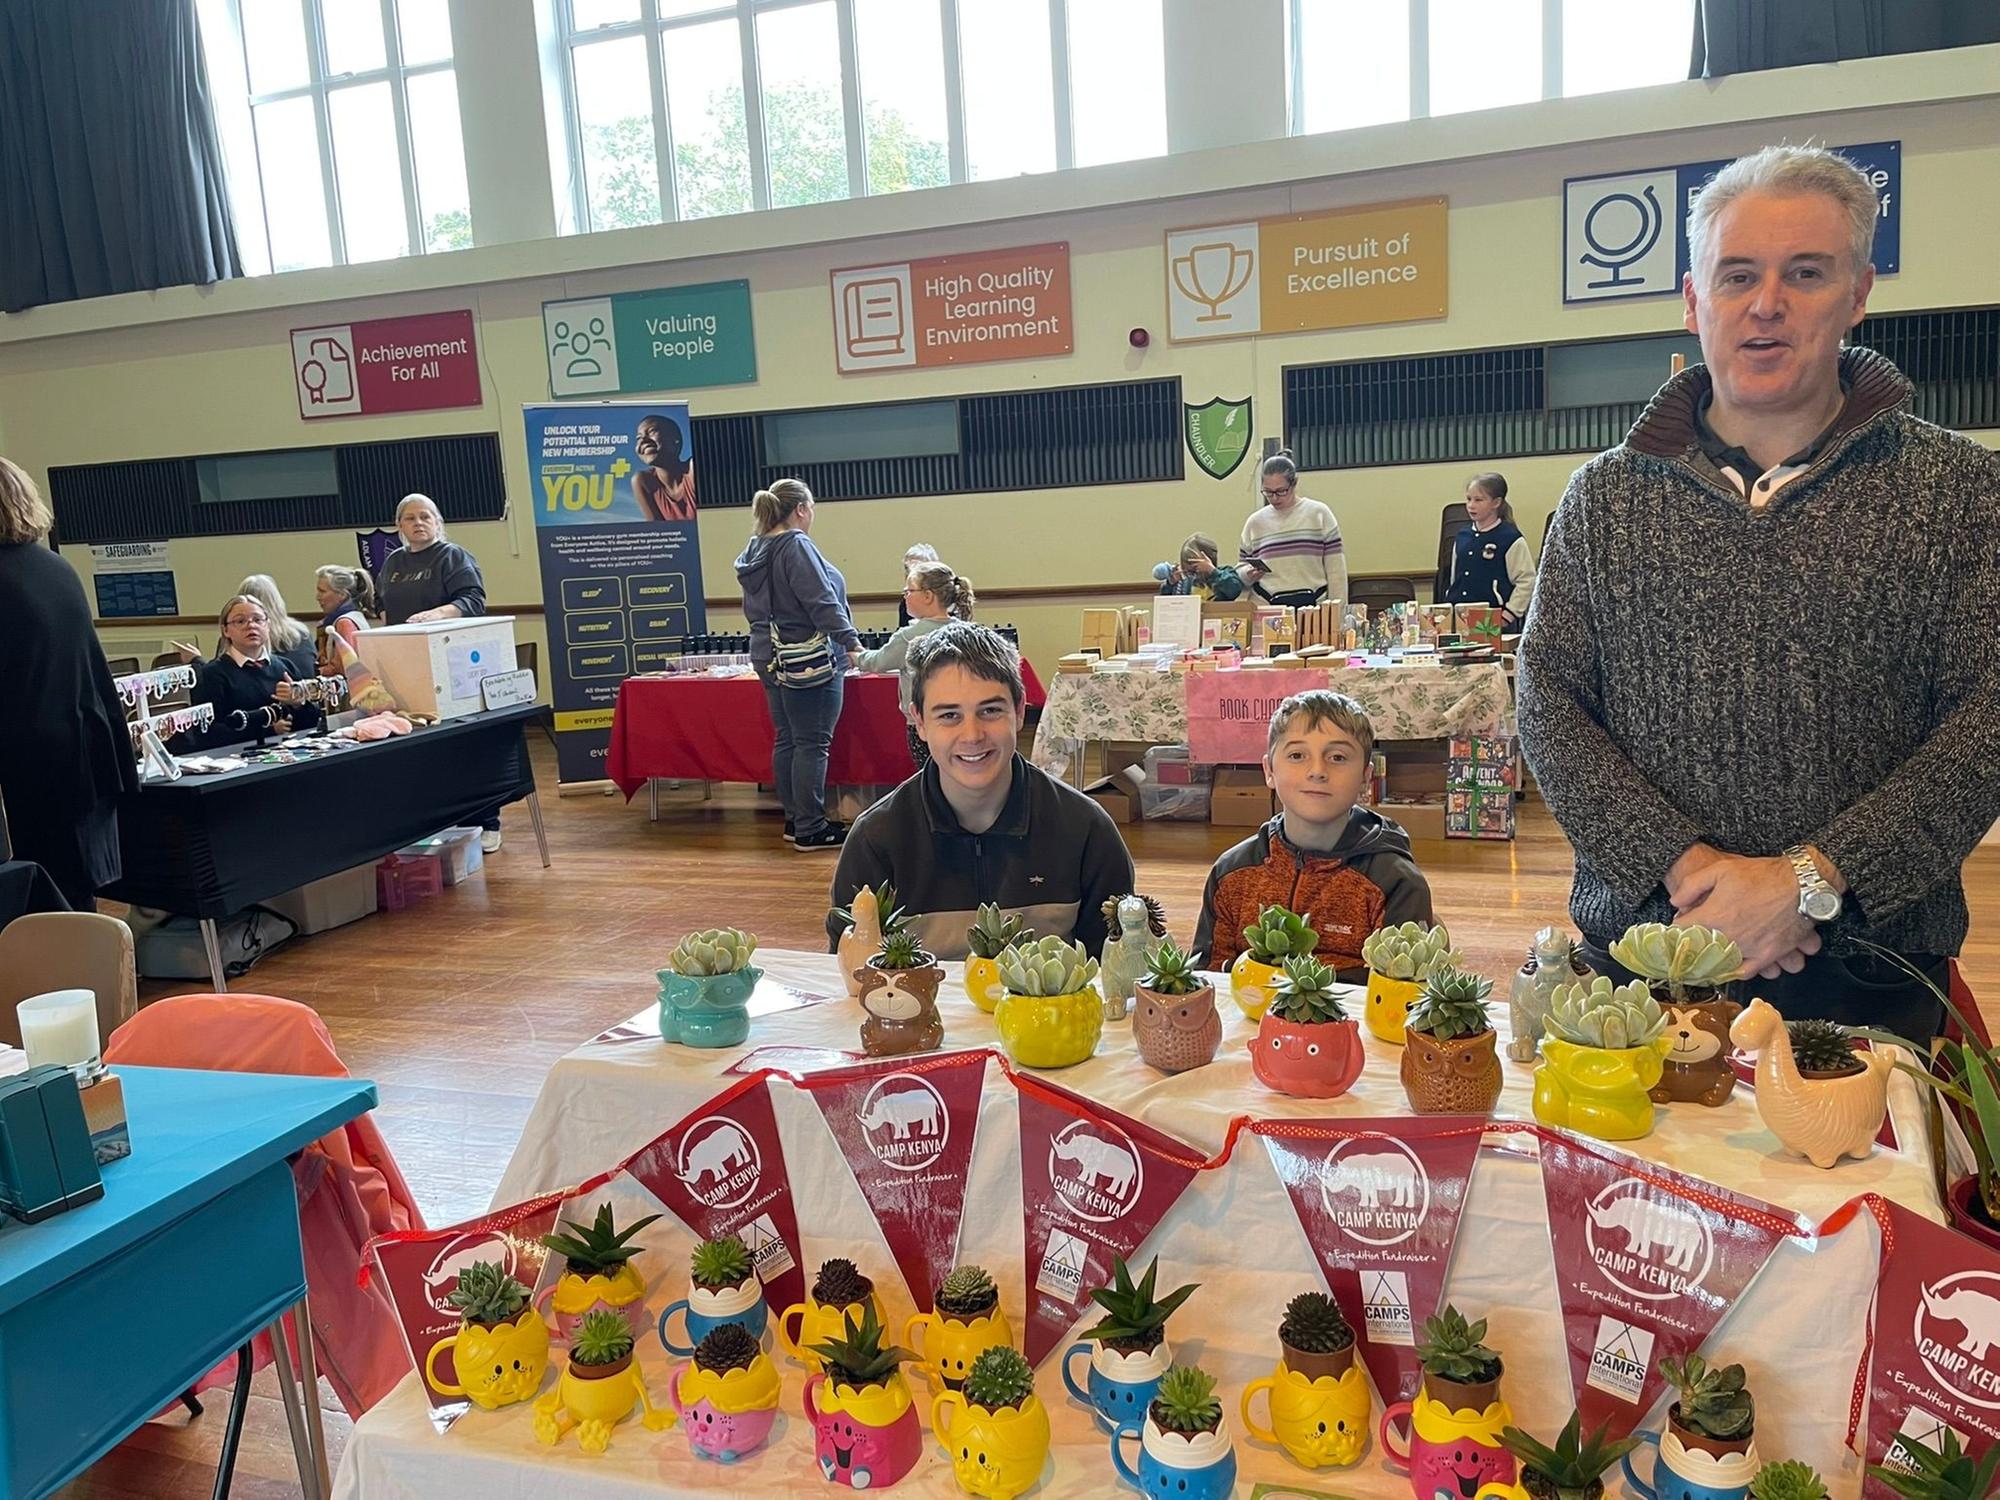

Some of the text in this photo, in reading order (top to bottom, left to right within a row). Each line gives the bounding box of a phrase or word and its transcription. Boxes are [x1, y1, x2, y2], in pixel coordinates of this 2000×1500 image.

[1293, 233, 1411, 267] Pursuit of
[926, 265, 1054, 300] High Quality
[1287, 262, 1418, 295] Excellence
[945, 295, 1037, 326] Learning
[645, 314, 717, 338] Valuing
[926, 316, 1059, 347] Environment
[360, 338, 468, 365] Achievement
[652, 337, 715, 361] People
[391, 361, 440, 382] For All
[543, 435, 629, 447] POTENTIAL WITH OUR
[544, 424, 600, 436] UNLOCK YOUR
[1190, 412, 1216, 468] CHAUNDLER
[542, 446, 617, 457] NEW MEMBERSHIP
[104, 544, 153, 558] SAFEGUARDING
[361, 540, 373, 568] ADLAM
[1219, 698, 1249, 720] BOOK
[876, 1138, 942, 1160] CAMP KENYA
[703, 1164, 761, 1207] CAMP KENYA
[876, 1173, 953, 1188] Expedition Fundraiser
[1053, 1174, 1122, 1219] CAMP KENYA
[1039, 1203, 1119, 1248] Expedition Fundraiser
[1337, 1211, 1419, 1230] CAMP KENYA
[753, 1239, 786, 1265] CAMPS
[1334, 1248, 1429, 1262] Expedition Fundraiser
[1042, 1259, 1081, 1284] CAMPS
[1595, 1248, 1688, 1295] CAMP KENYA
[435, 1297, 453, 1310] CA
[1365, 1306, 1410, 1321] CAMPS
[1579, 1281, 1689, 1331] Expedition Fundraiser
[1593, 1351, 1645, 1381] CAMPS
[1919, 1337, 2000, 1397] CAMP KEN
[1894, 1370, 2000, 1440] Expedition Fundrais
